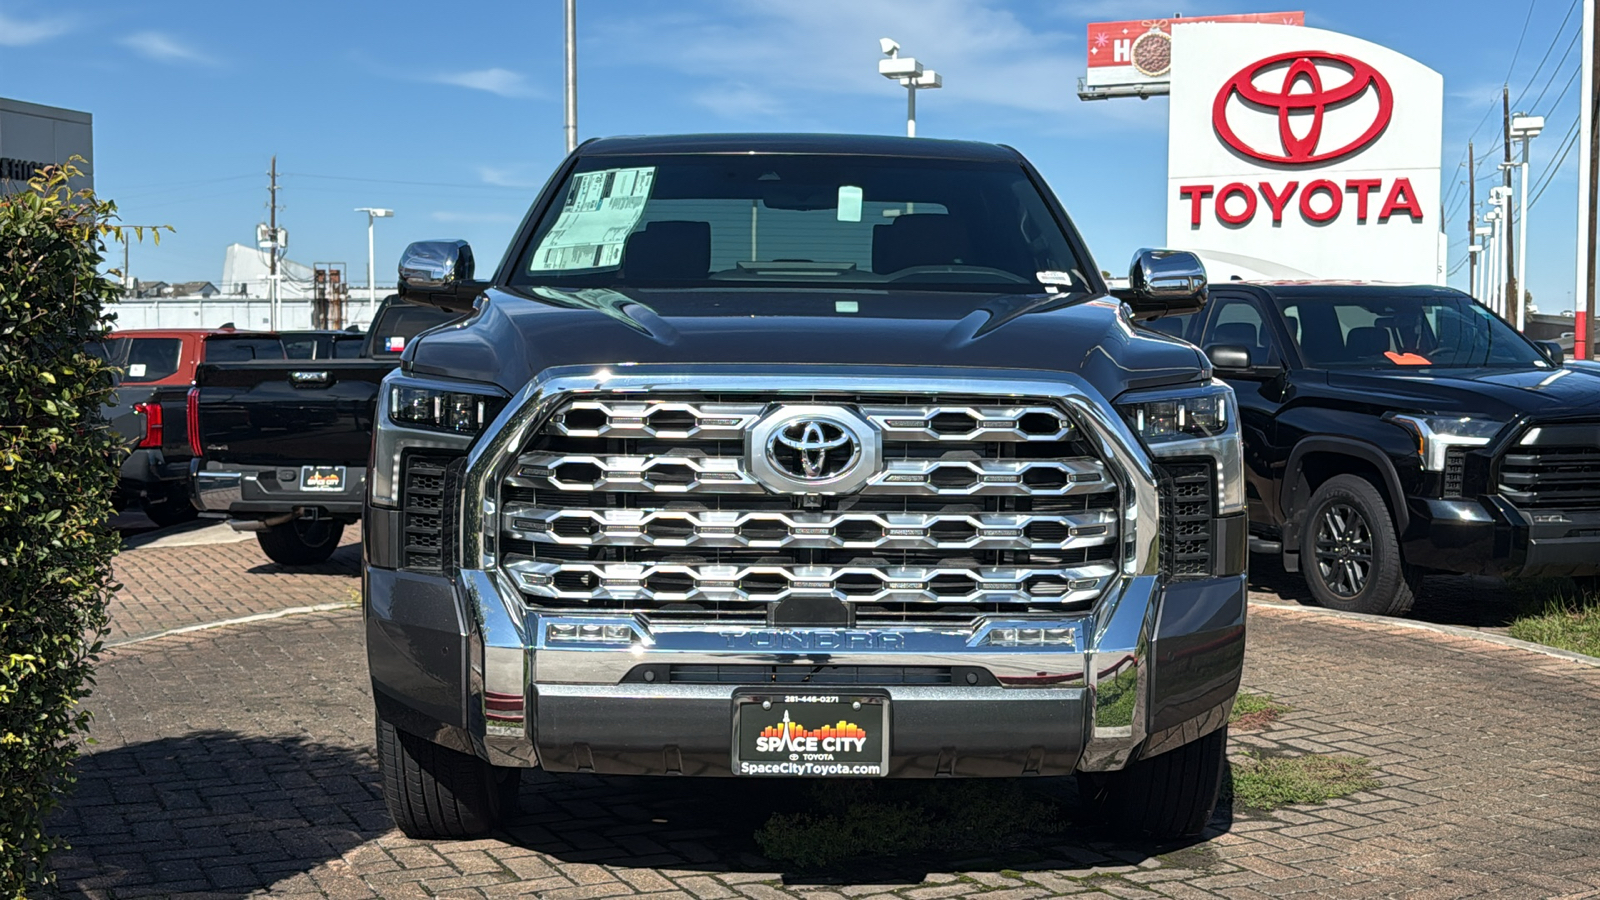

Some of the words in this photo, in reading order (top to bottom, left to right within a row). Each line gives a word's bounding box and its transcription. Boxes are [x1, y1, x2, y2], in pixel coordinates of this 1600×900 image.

[1180, 178, 1424, 226] TOYOTA
[718, 630, 905, 649] TUNDRA
[756, 736, 818, 752] SPACE
[821, 737, 867, 752] CITY
[802, 753, 835, 761] TOYOTA
[741, 762, 880, 776] SpaceCityToyota.com
